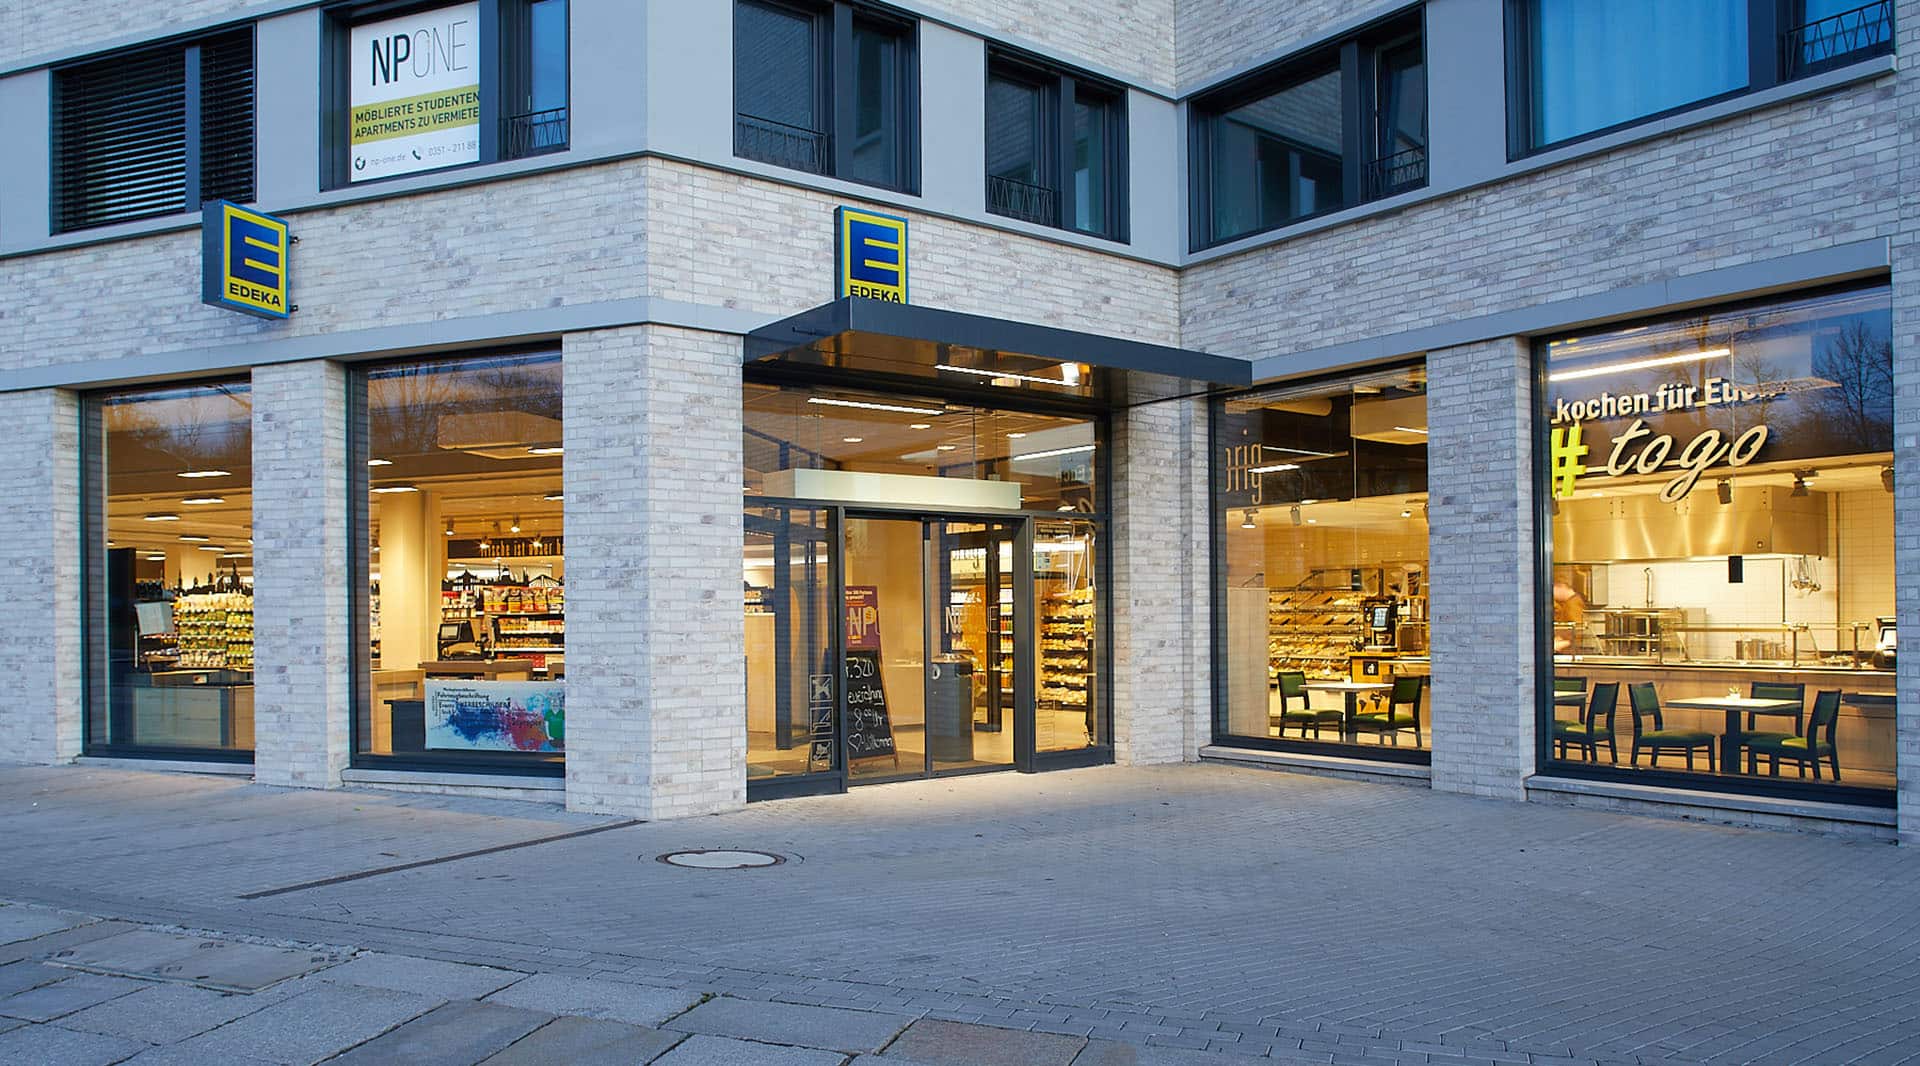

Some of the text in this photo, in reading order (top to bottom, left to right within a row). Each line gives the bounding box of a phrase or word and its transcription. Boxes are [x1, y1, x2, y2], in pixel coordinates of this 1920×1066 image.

[355, 91, 480, 124] MÖBLIERTE STUDENTEN
[354, 106, 480, 138] APARTMENTS ZU VERMIETE
[229, 282, 281, 307] EDEKA
[850, 285, 901, 304] EDEKA
